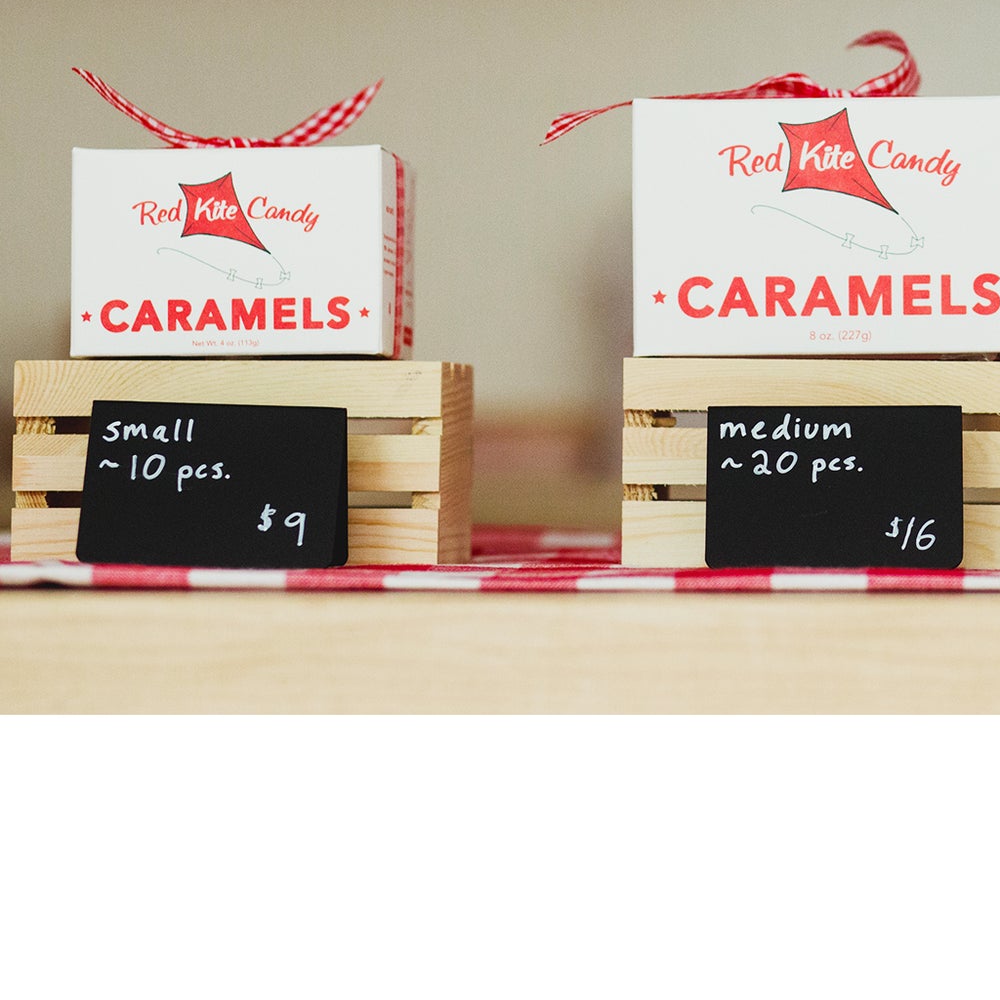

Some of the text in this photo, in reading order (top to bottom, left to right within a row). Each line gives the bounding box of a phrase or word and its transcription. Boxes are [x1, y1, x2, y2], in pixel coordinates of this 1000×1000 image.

[717, 139, 963, 187] Red Kite Candy
[132, 196, 320, 233] Red Kite Candy
[99, 295, 351, 334] CARAMELS
[809, 330, 816, 341] 8
[838, 329, 872, 343] (227g)
[102, 418, 195, 443] small
[719, 413, 852, 441] medium
[177, 460, 231, 492] pcs.
[811, 455, 864, 484] pcs.
[257, 503, 307, 547] $9
[885, 516, 936, 551] $16
